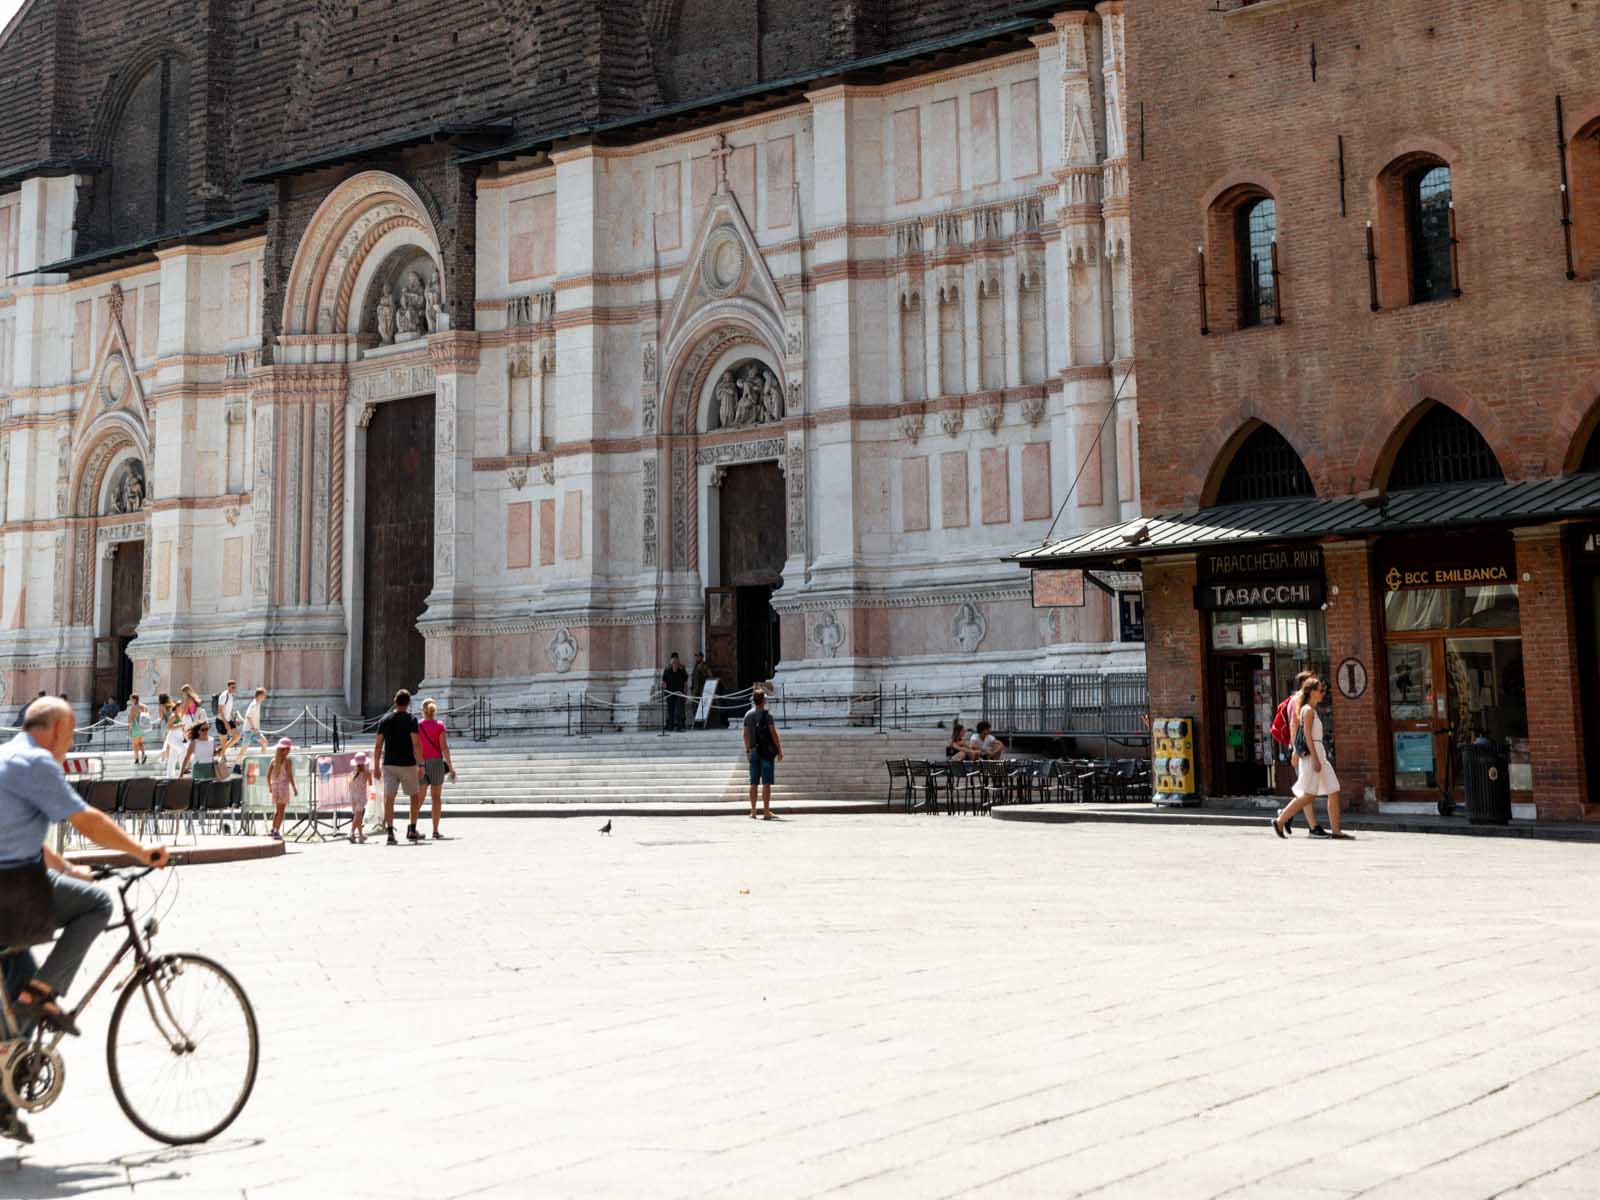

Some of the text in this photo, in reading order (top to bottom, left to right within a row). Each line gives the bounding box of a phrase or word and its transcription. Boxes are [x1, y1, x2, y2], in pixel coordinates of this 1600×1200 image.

[1405, 571, 1429, 584] BCC
[1435, 567, 1508, 583] EMILBANCA
[1211, 584, 1311, 606] TABACCHI
[1123, 594, 1141, 625] T
